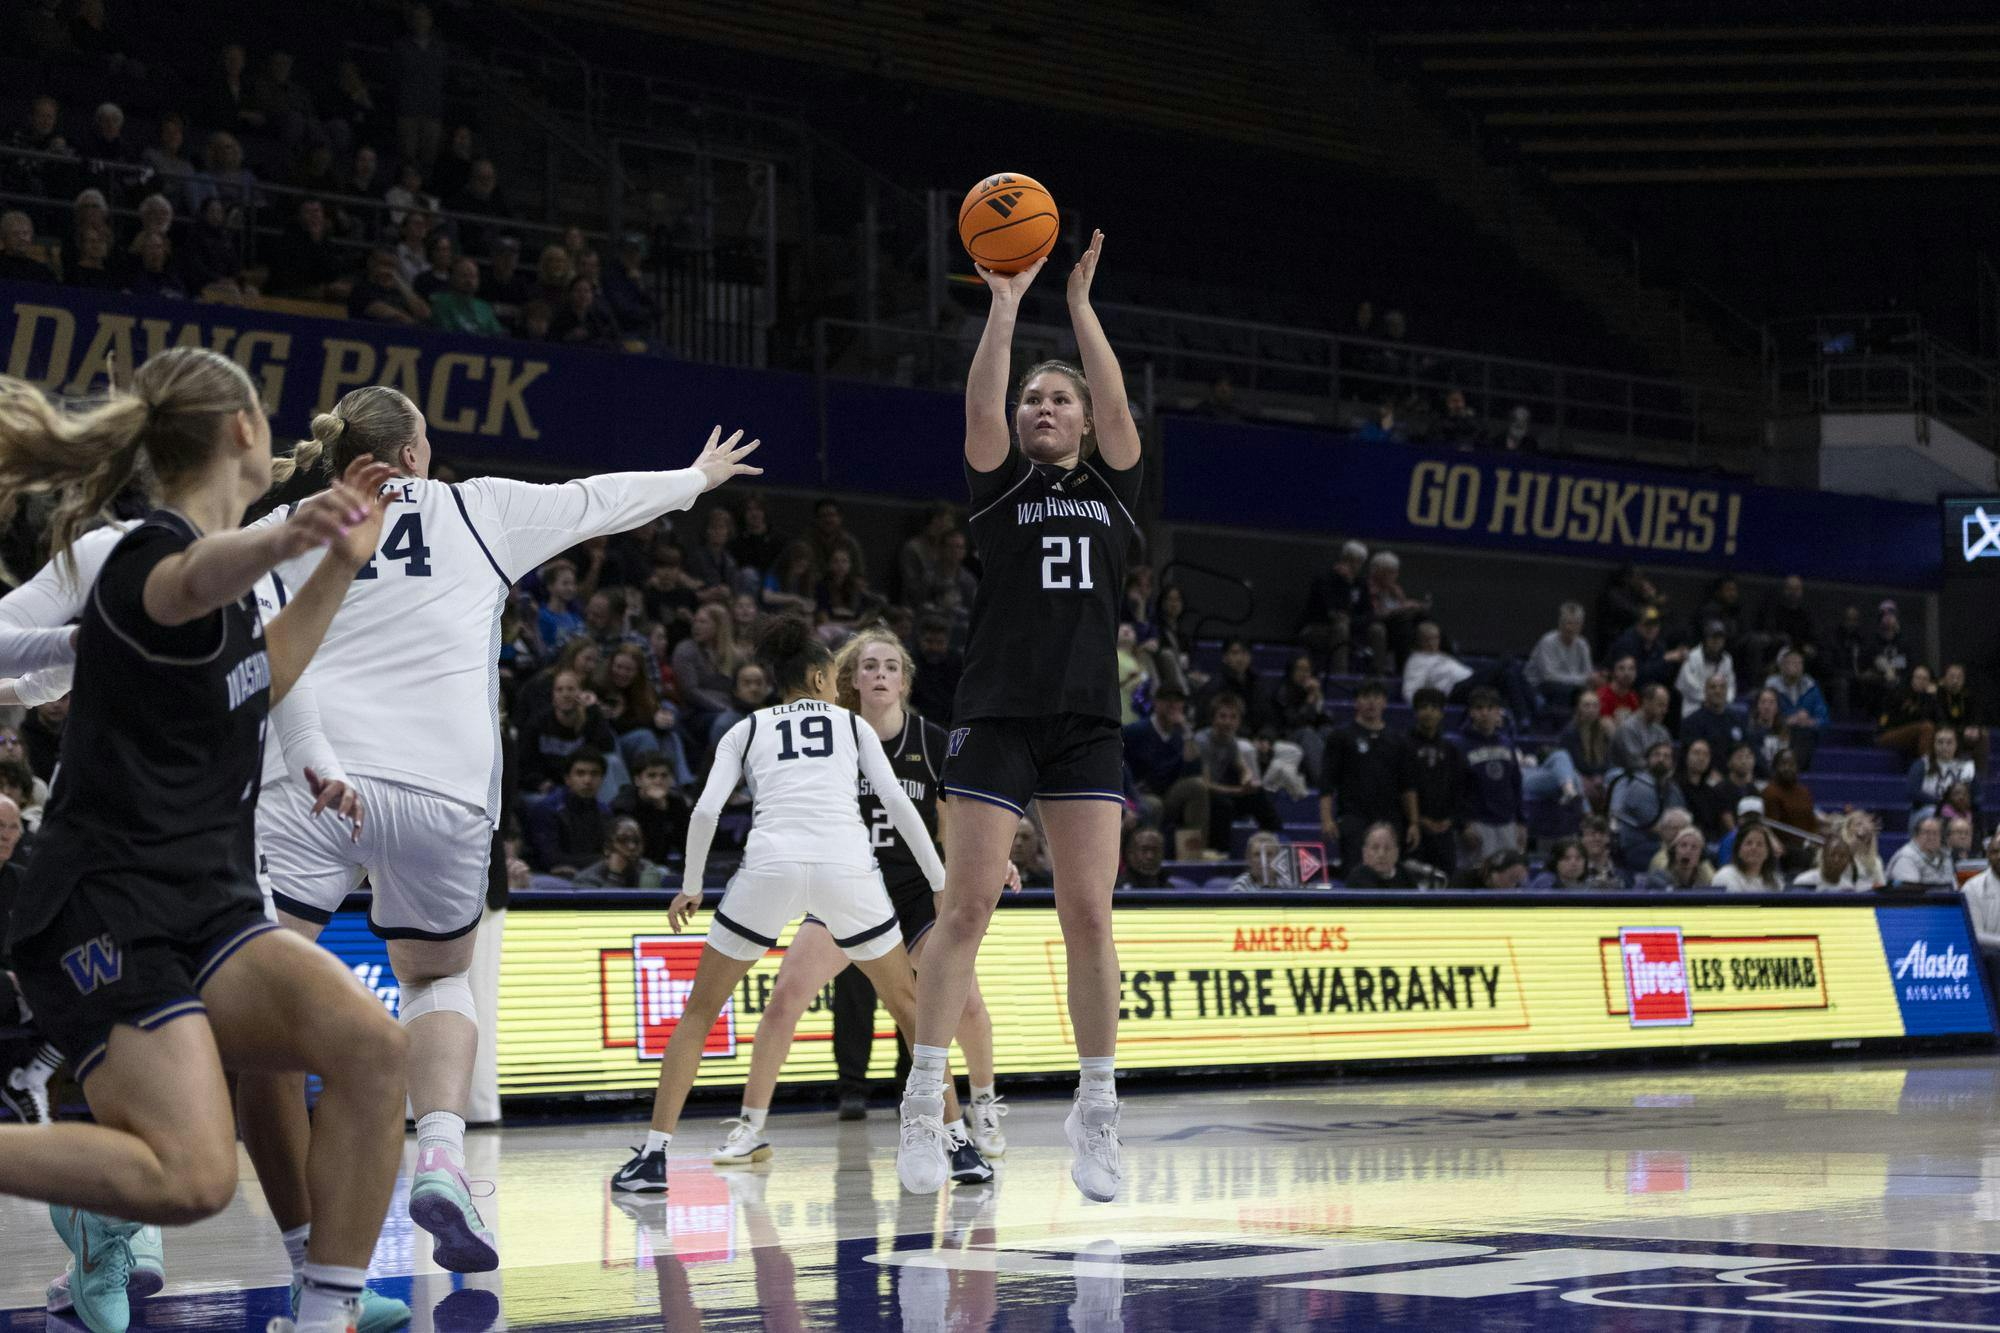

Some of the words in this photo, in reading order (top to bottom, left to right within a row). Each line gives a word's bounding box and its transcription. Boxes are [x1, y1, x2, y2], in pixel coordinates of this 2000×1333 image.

[1017, 496, 1111, 528] WAHINGTON
[1406, 460, 1482, 530] GO
[1041, 536, 1094, 590] 21
[775, 715, 834, 762] 19
[1232, 926, 1350, 953] AMERICA'S
[1893, 939, 1970, 983] Alaska
[60, 932, 122, 997] W
[1623, 943, 1685, 1001] Tires
[1691, 958, 1725, 992] LES
[1730, 956, 1817, 991] SCHWAB
[742, 973, 780, 1014] LE
[1188, 968, 1276, 1019] TIRE
[1285, 964, 1502, 1016] WARRANTY
